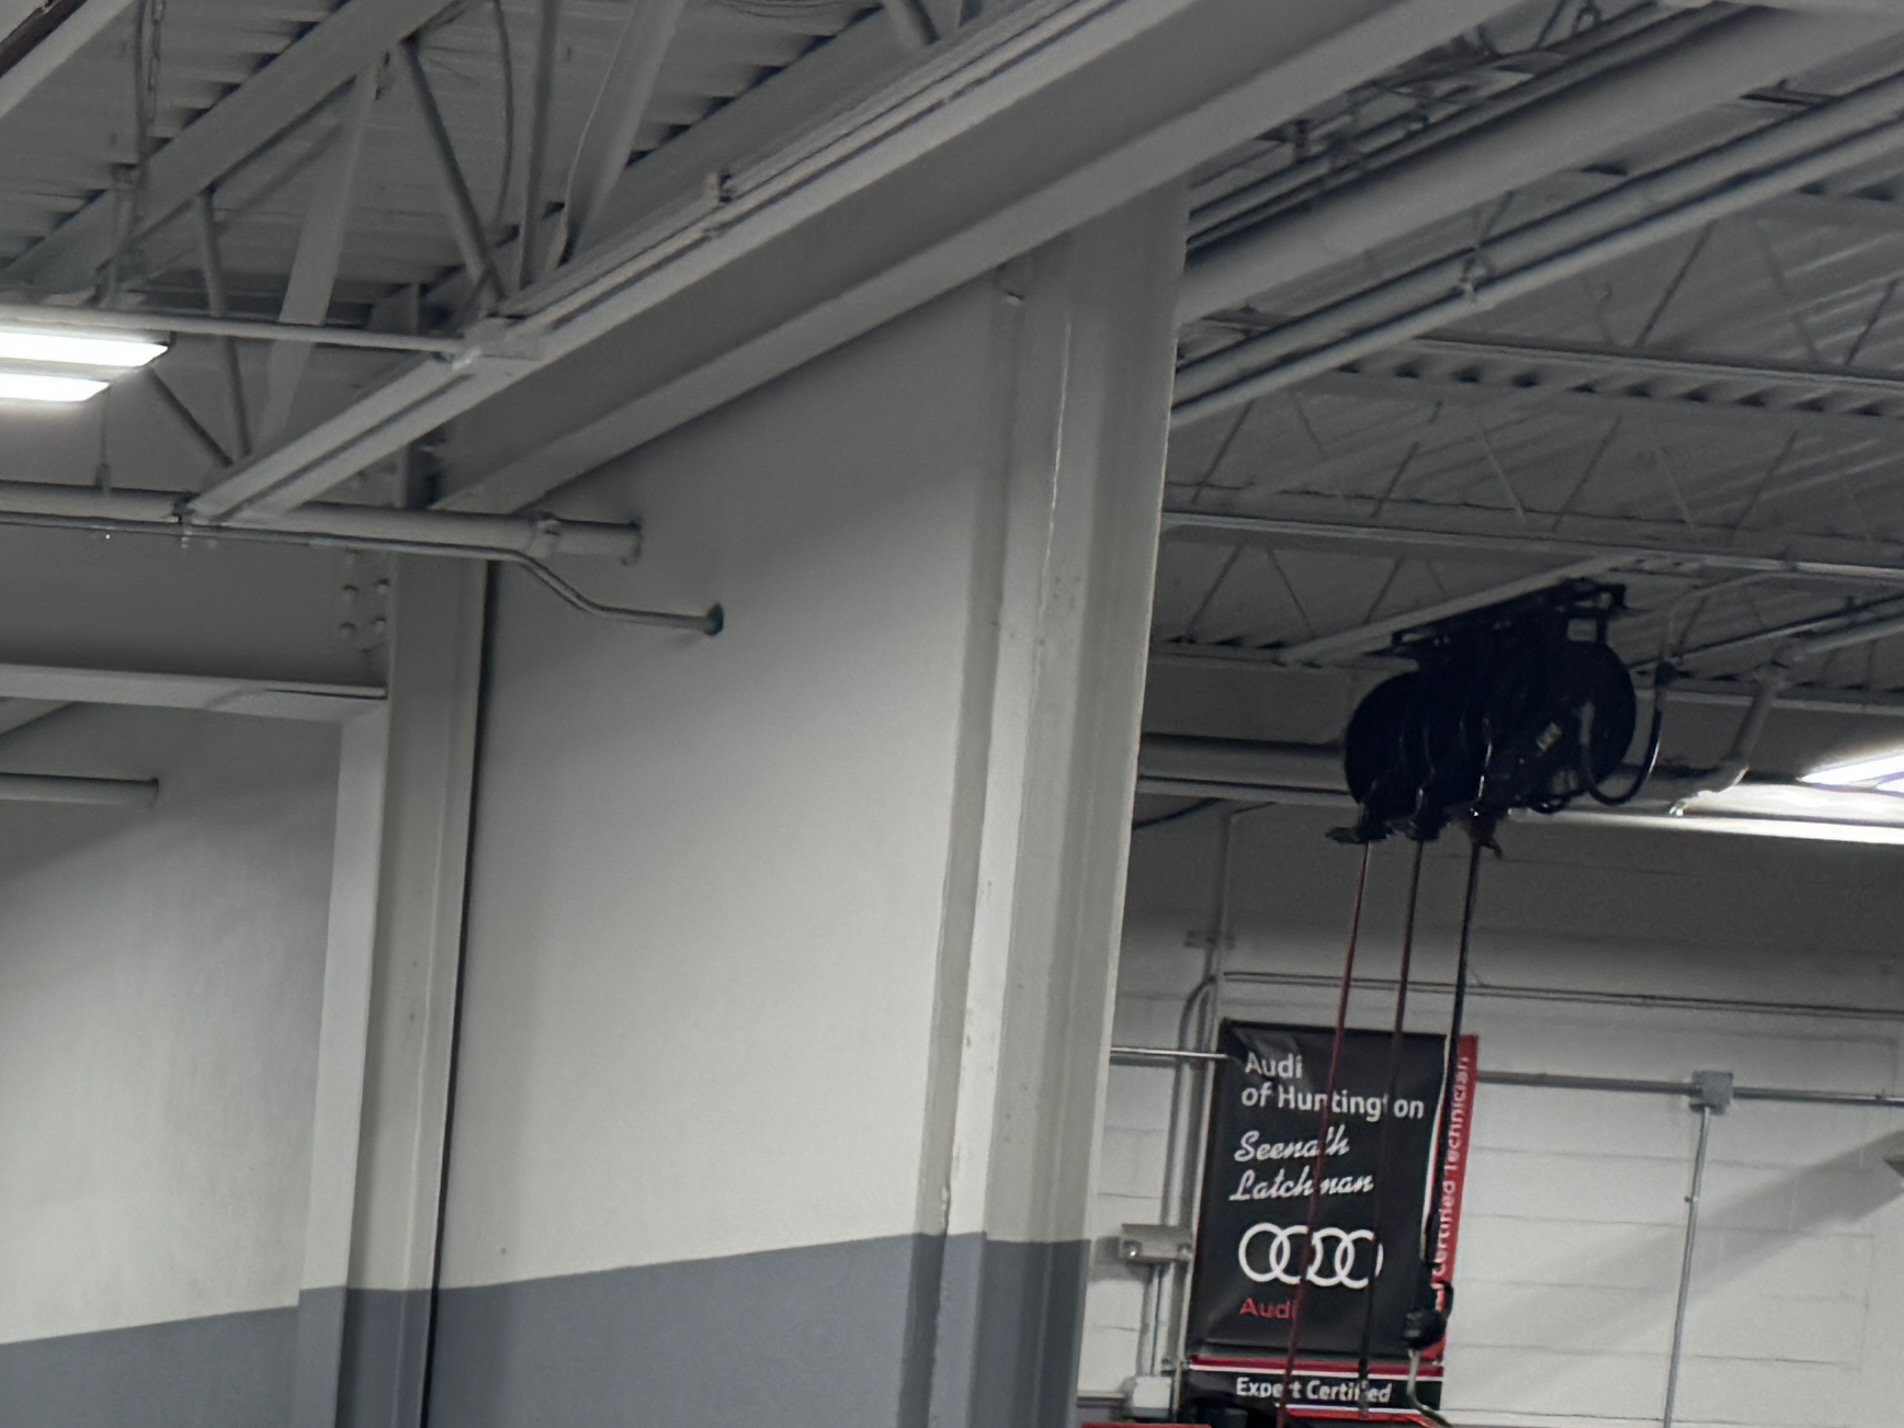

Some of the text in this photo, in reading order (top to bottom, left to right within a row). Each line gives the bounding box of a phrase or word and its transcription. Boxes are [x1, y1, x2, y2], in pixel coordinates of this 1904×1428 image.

[1244, 1051, 1303, 1079] Audi
[1242, 1081, 1273, 1107] of
[1235, 1377, 1302, 1400] Expet
